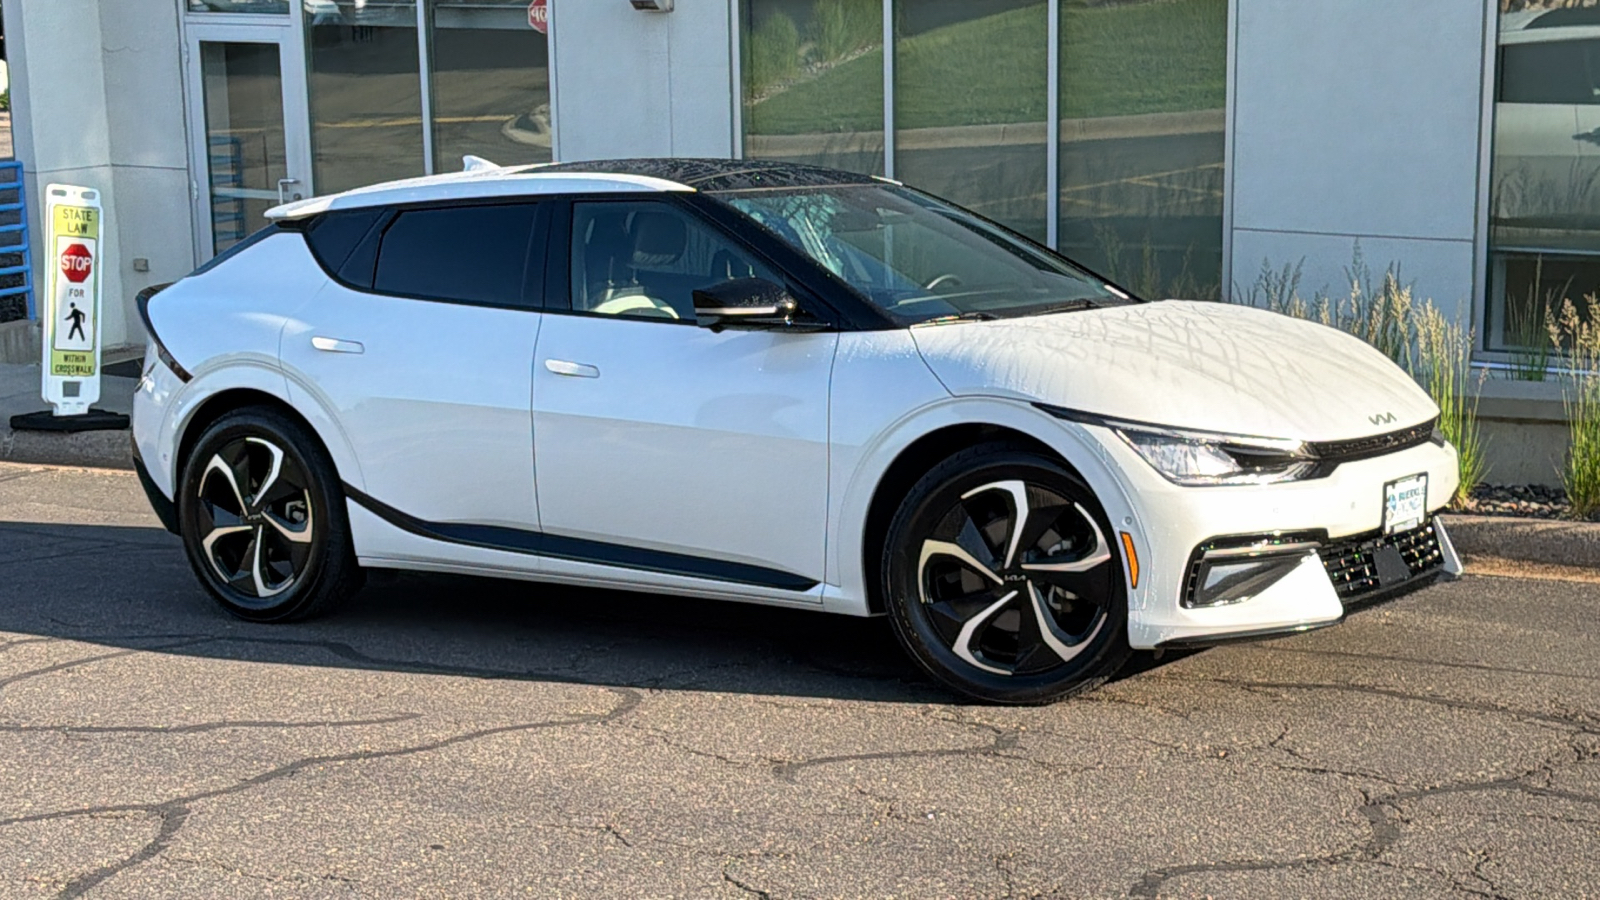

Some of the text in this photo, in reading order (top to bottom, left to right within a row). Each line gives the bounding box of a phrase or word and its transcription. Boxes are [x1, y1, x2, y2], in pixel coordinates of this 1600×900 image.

[63, 208, 92, 222] STATE
[67, 222, 88, 235] LAW
[61, 255, 91, 271] STOP
[68, 288, 84, 298] FOR
[63, 354, 86, 363] WITHIN
[55, 364, 92, 374] CROSSWALK
